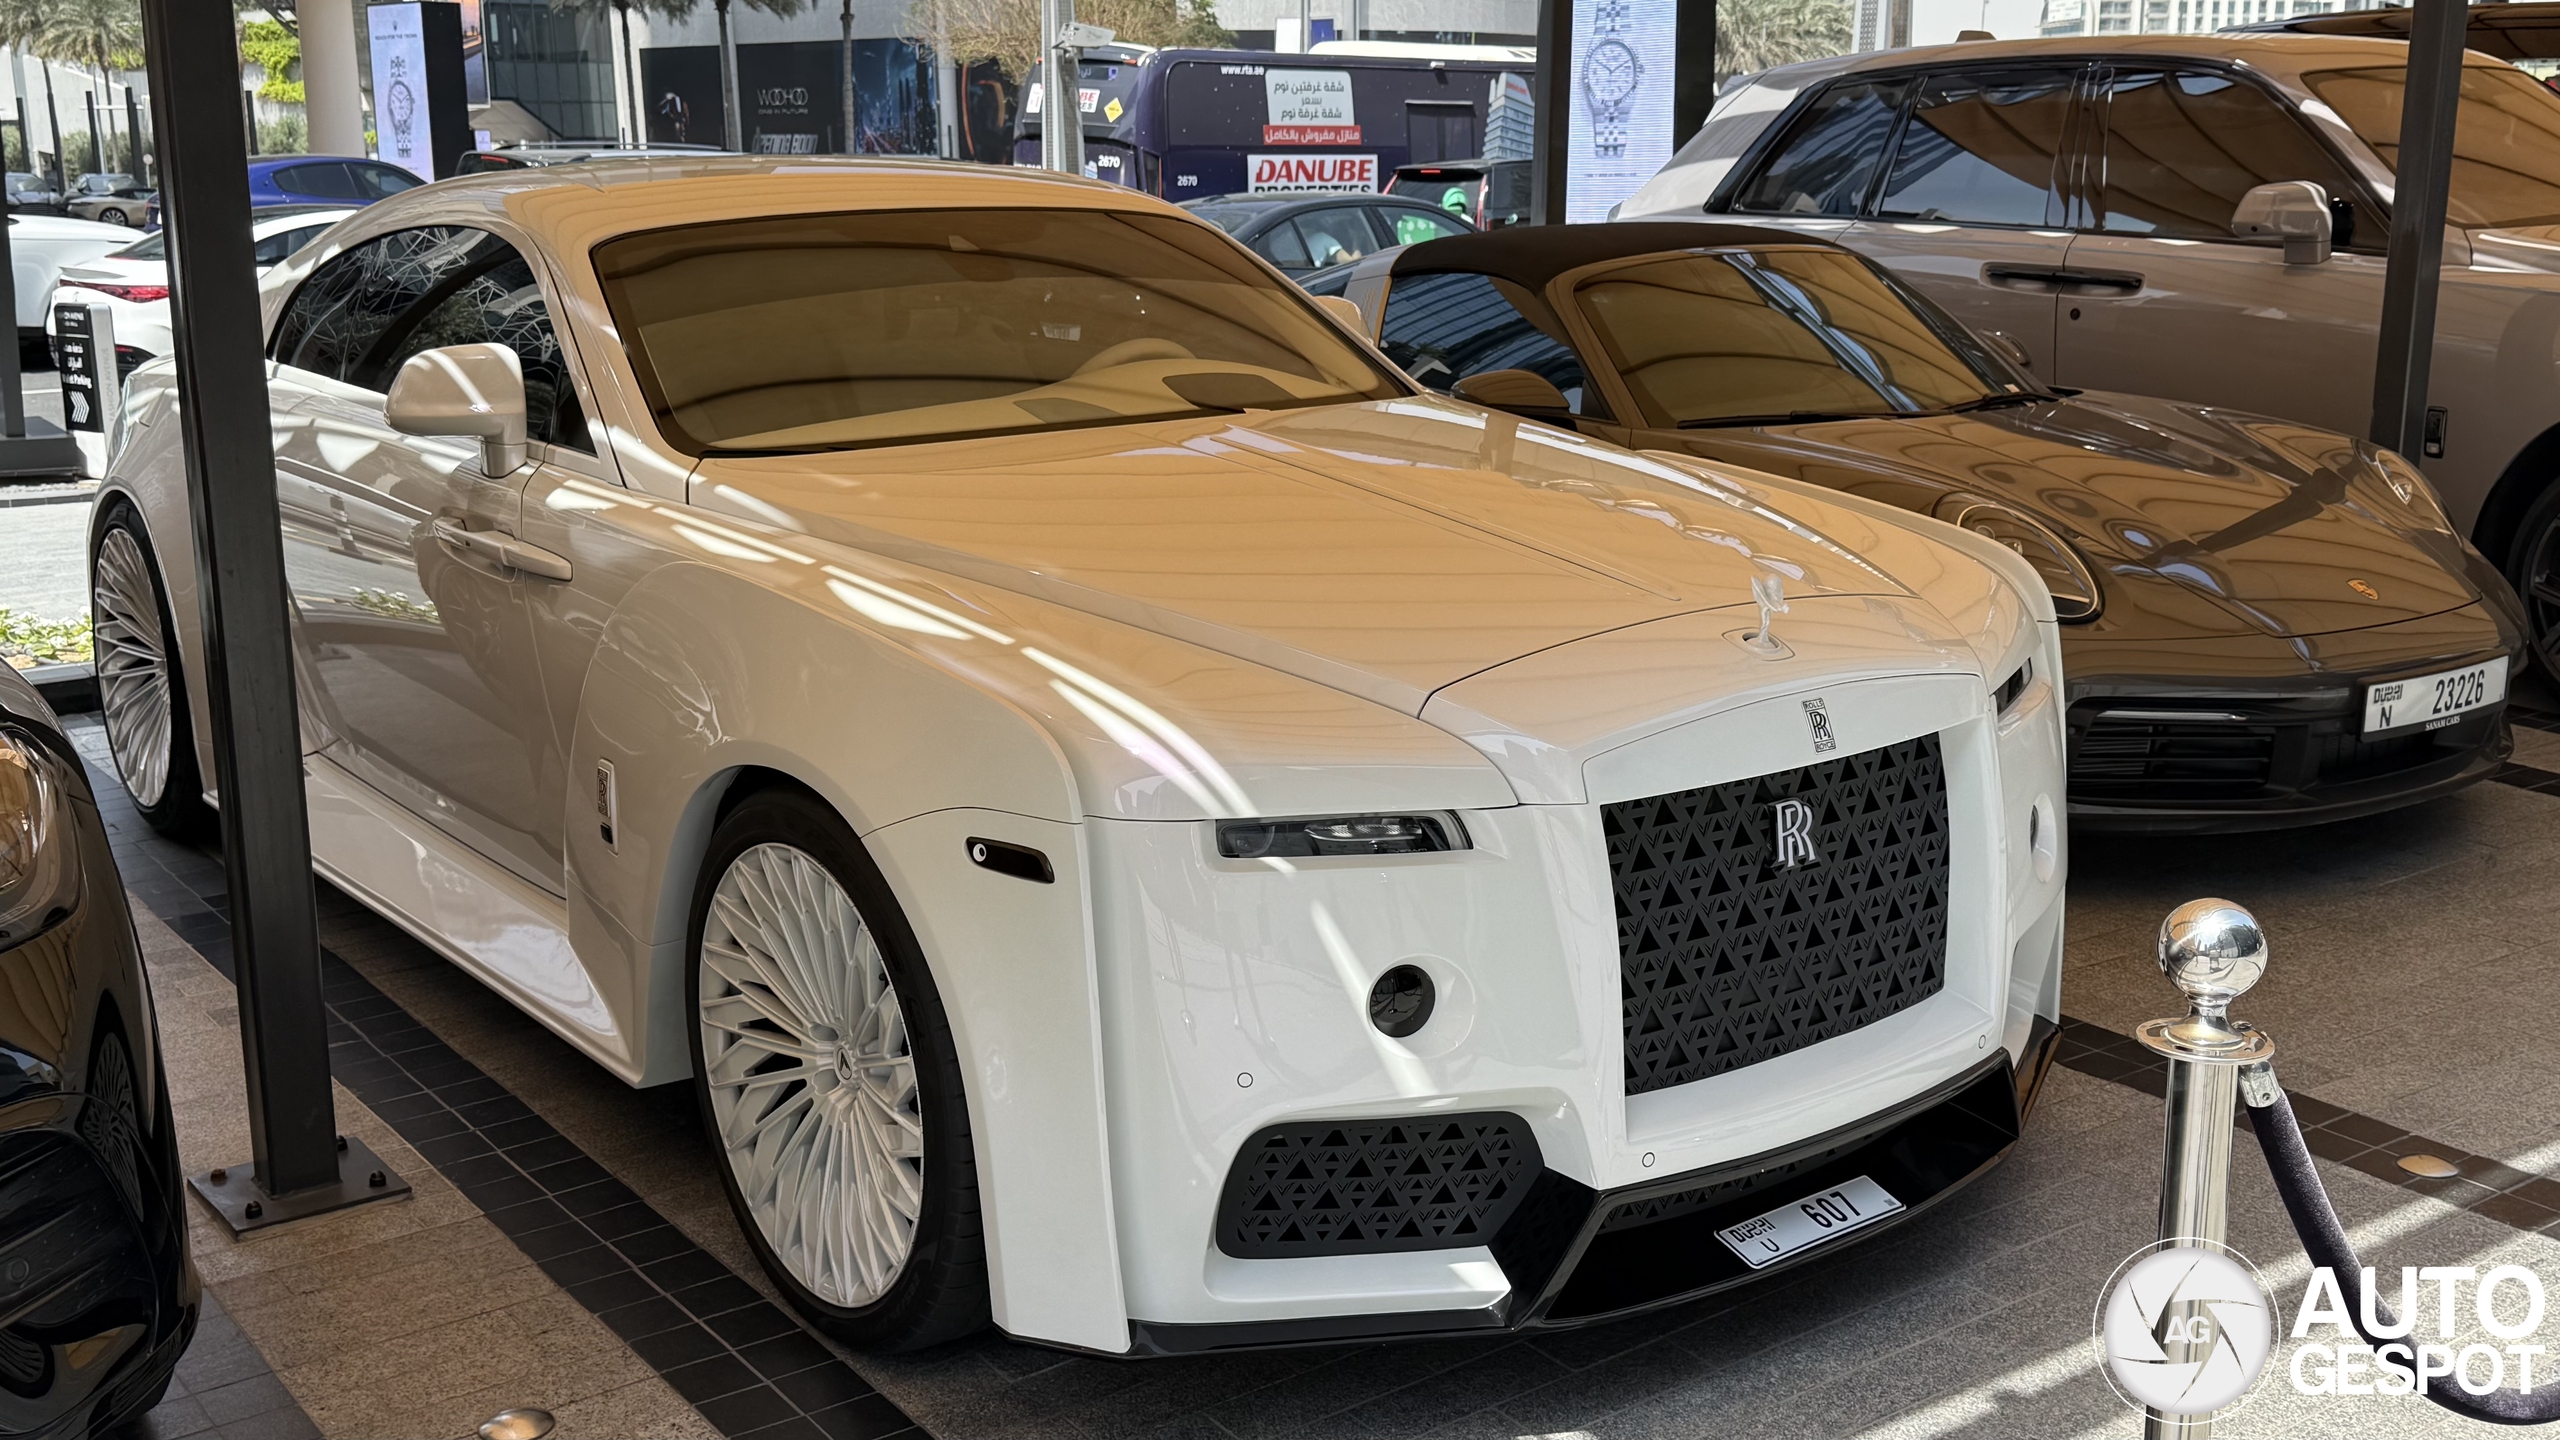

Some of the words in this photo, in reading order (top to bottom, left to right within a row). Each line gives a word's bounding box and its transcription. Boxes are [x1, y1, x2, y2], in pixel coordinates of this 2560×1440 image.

[1220, 65, 1264, 76] www.rta.ae
[1274, 81, 1289, 95] نوم
[1291, 82, 1322, 95] غرفتين
[1324, 82, 1345, 93] شقة
[757, 87, 809, 106] WOOHOO
[1281, 108, 1296, 122] نوم
[1298, 107, 1319, 121] غرفة
[1322, 108, 1342, 119] شقة
[1264, 128, 1299, 143] بالكامل
[1300, 128, 1336, 143] مفروش
[1336, 129, 1360, 143] منازل
[1097, 154, 1121, 168] 2670
[1255, 160, 1373, 183] DANUBE
[1177, 175, 1198, 187] 2670
[2432, 669, 2486, 715] 23226
[1804, 700, 1824, 711] ROLLS
[2379, 705, 2393, 729] N
[2425, 719, 2446, 732] SANAM
[2445, 714, 2461, 727] CARS
[1815, 740, 1836, 751] ROYCE
[1800, 1191, 1861, 1229] 607
[1759, 1238, 1780, 1253] U
